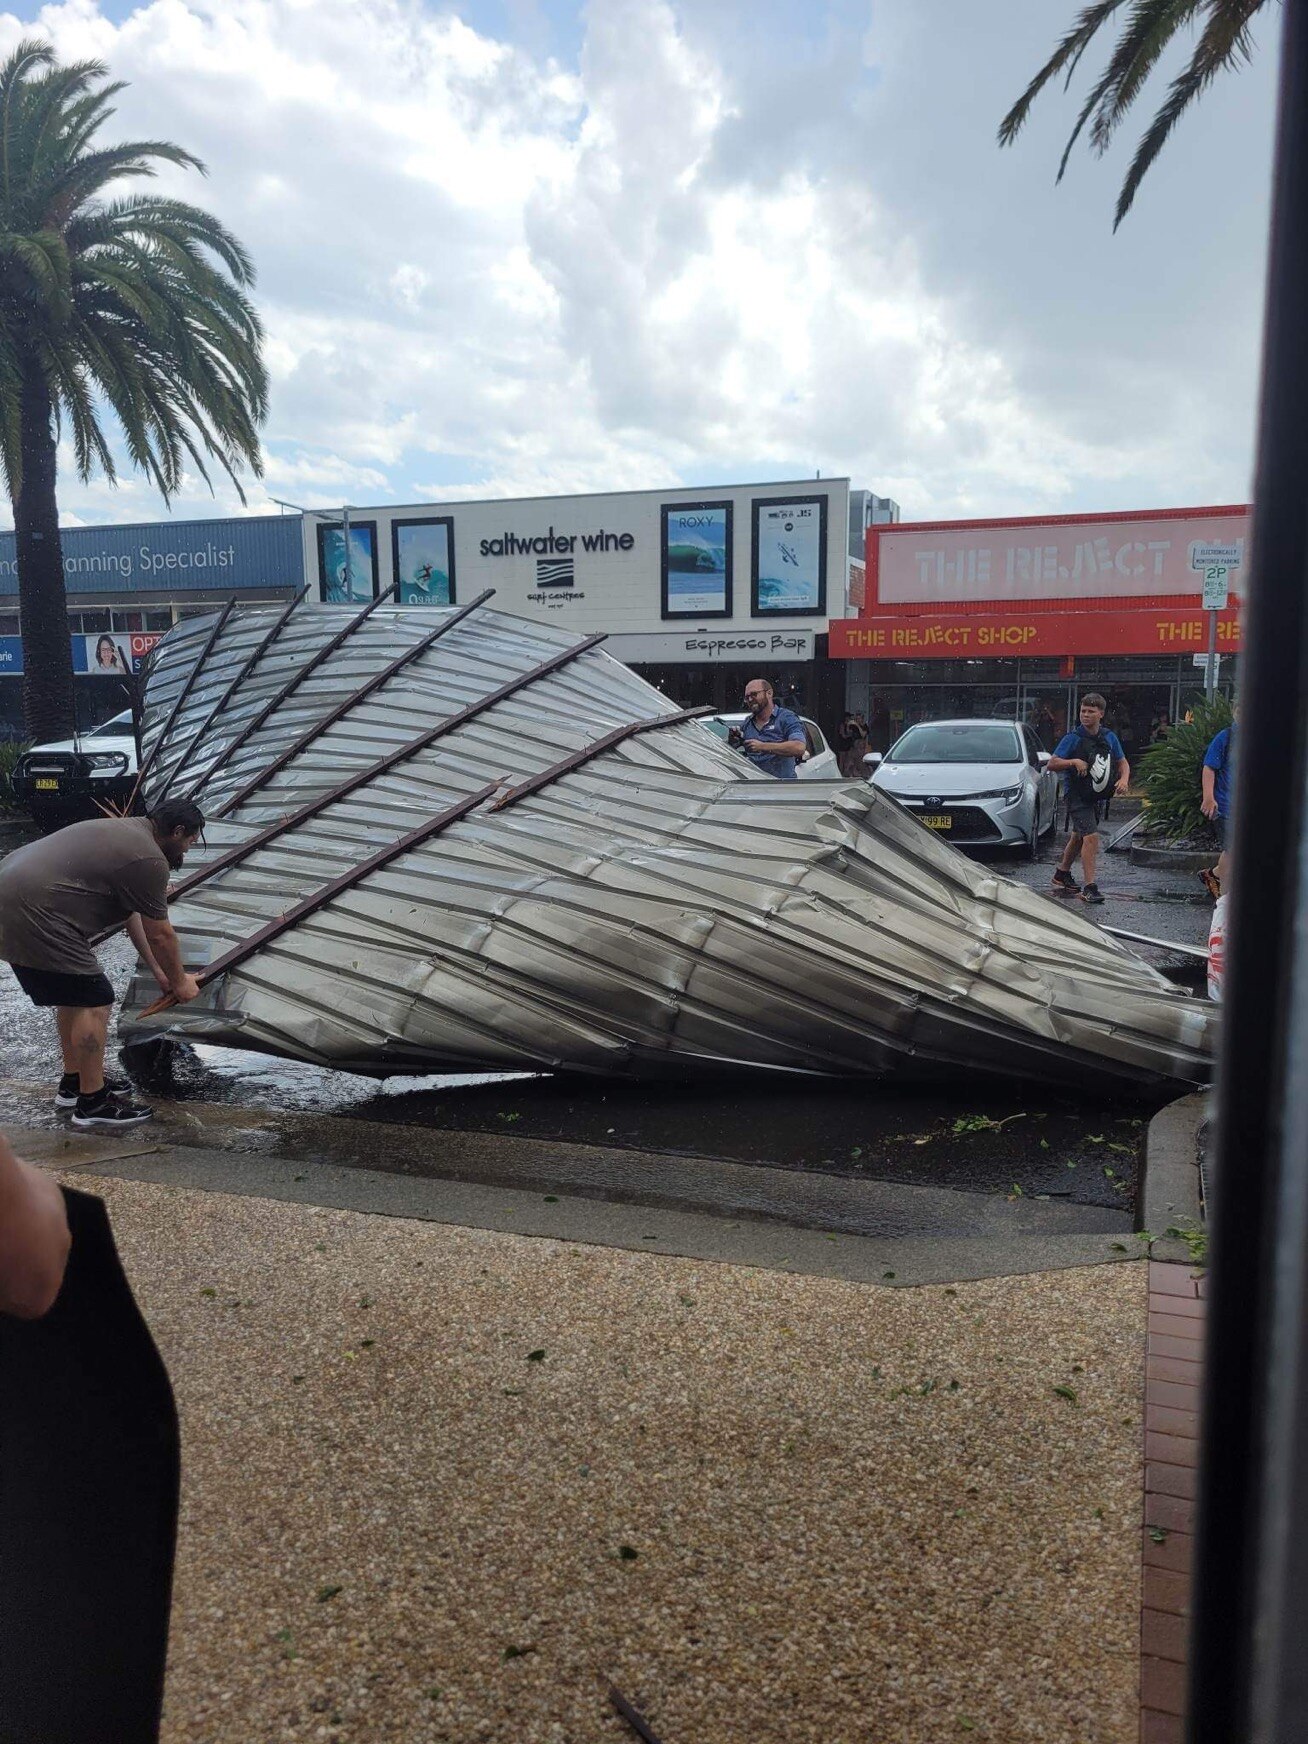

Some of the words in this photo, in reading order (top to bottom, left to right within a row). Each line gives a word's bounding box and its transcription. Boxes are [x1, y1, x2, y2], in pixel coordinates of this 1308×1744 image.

[679, 516, 714, 528] ROXY
[480, 526, 577, 556] saltwater
[581, 529, 635, 552] wine
[62, 551, 132, 577] lanning
[139, 543, 235, 575] Specialist
[915, 548, 992, 585] THE
[1006, 537, 1171, 583] REJECT
[1207, 567, 1226, 578] 2P
[846, 629, 885, 647] THE
[891, 625, 971, 646] REJECT
[977, 626, 1037, 645] SHOP
[1156, 621, 1202, 640] THE
[685, 639, 767, 656] Espresso
[771, 635, 806, 654] Bar
